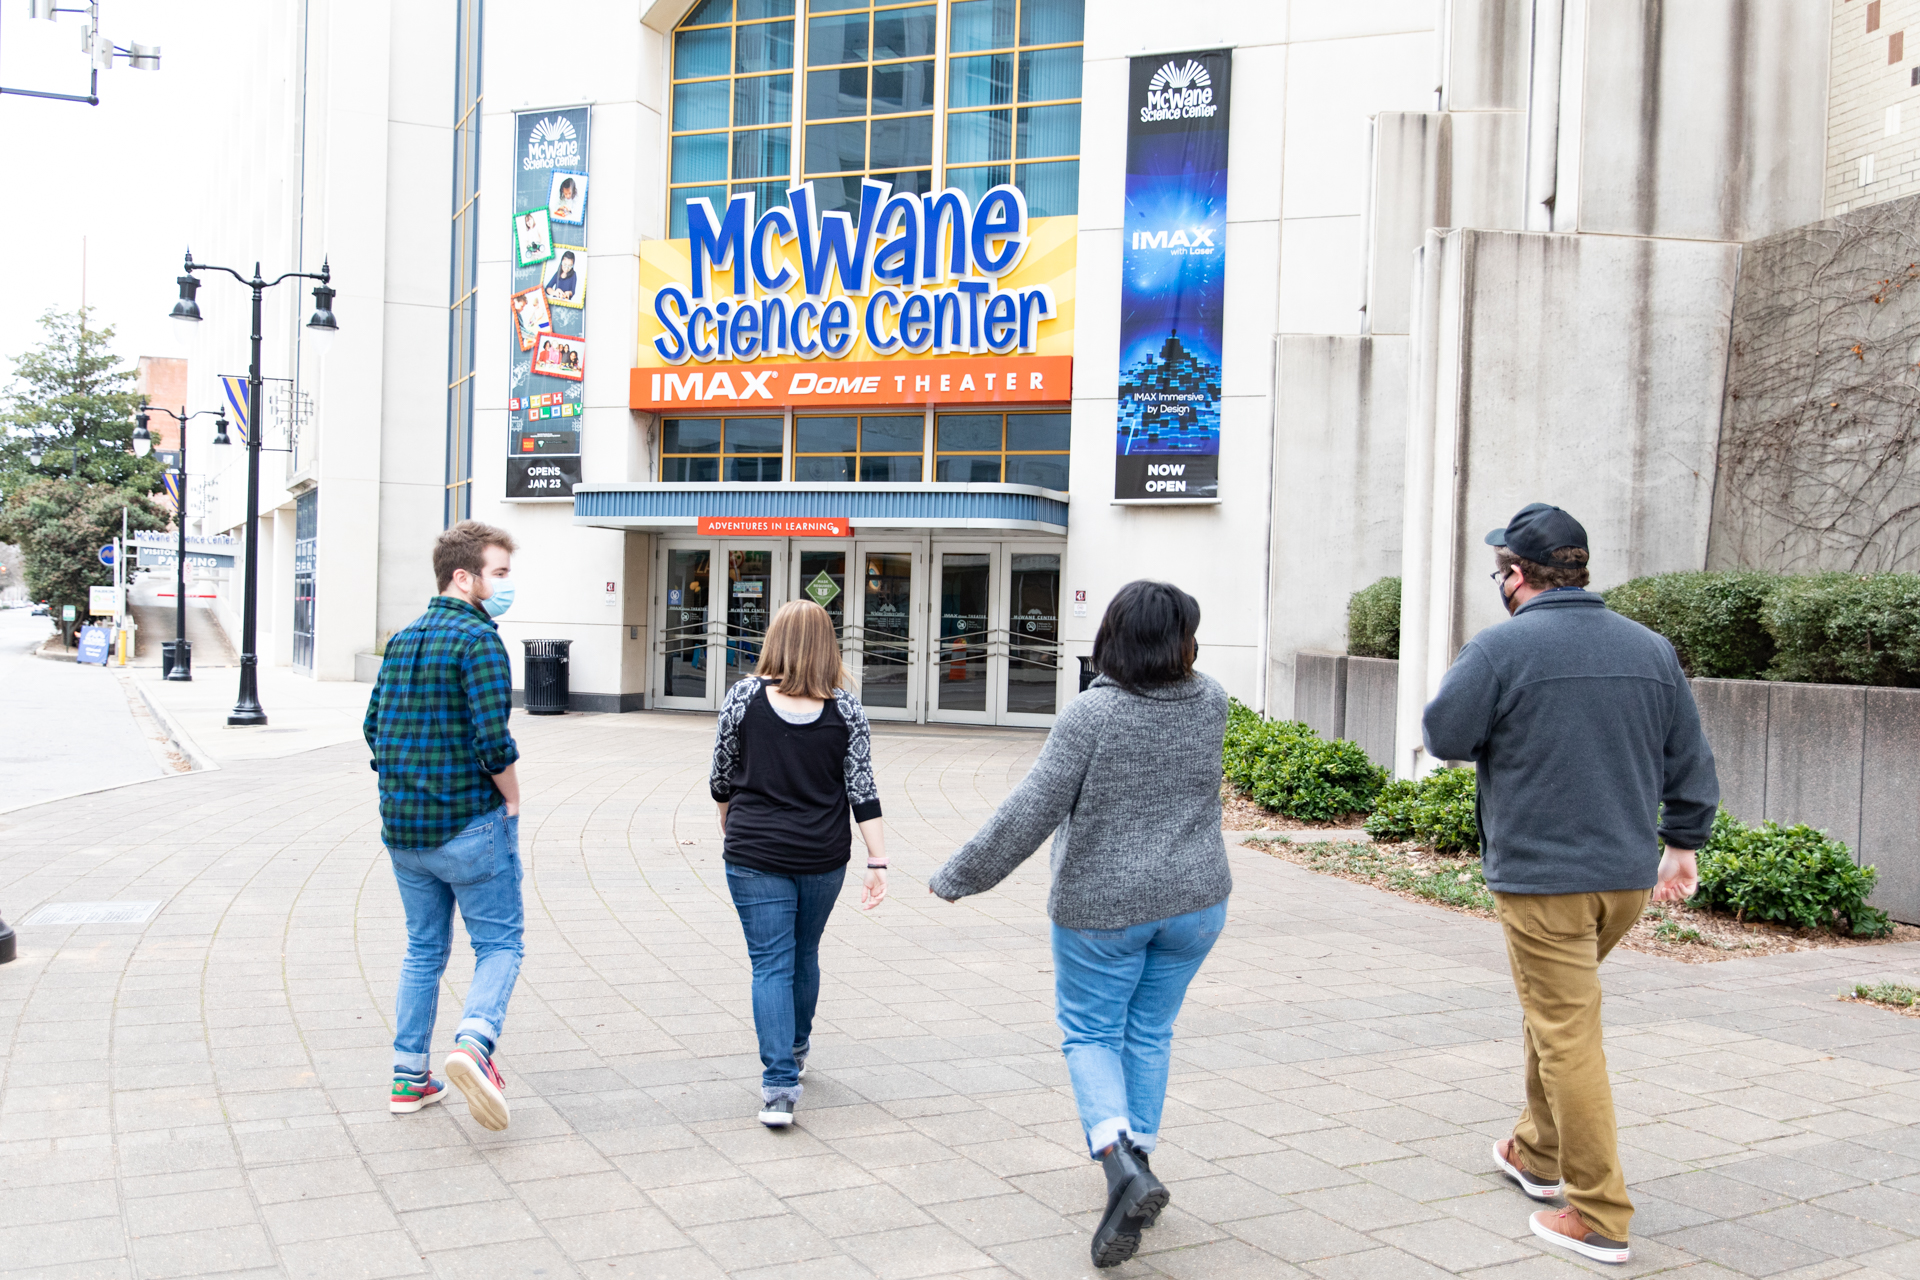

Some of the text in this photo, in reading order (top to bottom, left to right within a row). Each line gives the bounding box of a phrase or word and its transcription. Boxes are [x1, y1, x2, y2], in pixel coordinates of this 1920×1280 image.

[1148, 88, 1212, 110] McWane
[1140, 104, 1217, 122] Science Center
[528, 141, 577, 160] McWane
[523, 155, 580, 170] Science Center
[686, 178, 1030, 302] McWane
[1132, 229, 1214, 250] IMAX
[653, 278, 1056, 366] Science Center
[895, 372, 1044, 393] THEATER
[510, 393, 562, 409] BRICK
[1134, 393, 1204, 401] IMAX Immersive
[529, 403, 582, 420] OLOGY
[1147, 404, 1190, 416] by Design
[527, 467, 561, 476] OPENS
[1147, 464, 1186, 476] NOW
[527, 479, 561, 488] JAN 23
[1145, 480, 1187, 492] OPEN
[708, 522, 768, 531] ADVENTURES
[785, 522, 834, 531] LEARNING
[172, 532, 205, 544] Sence
[157, 556, 218, 568] PAKING
